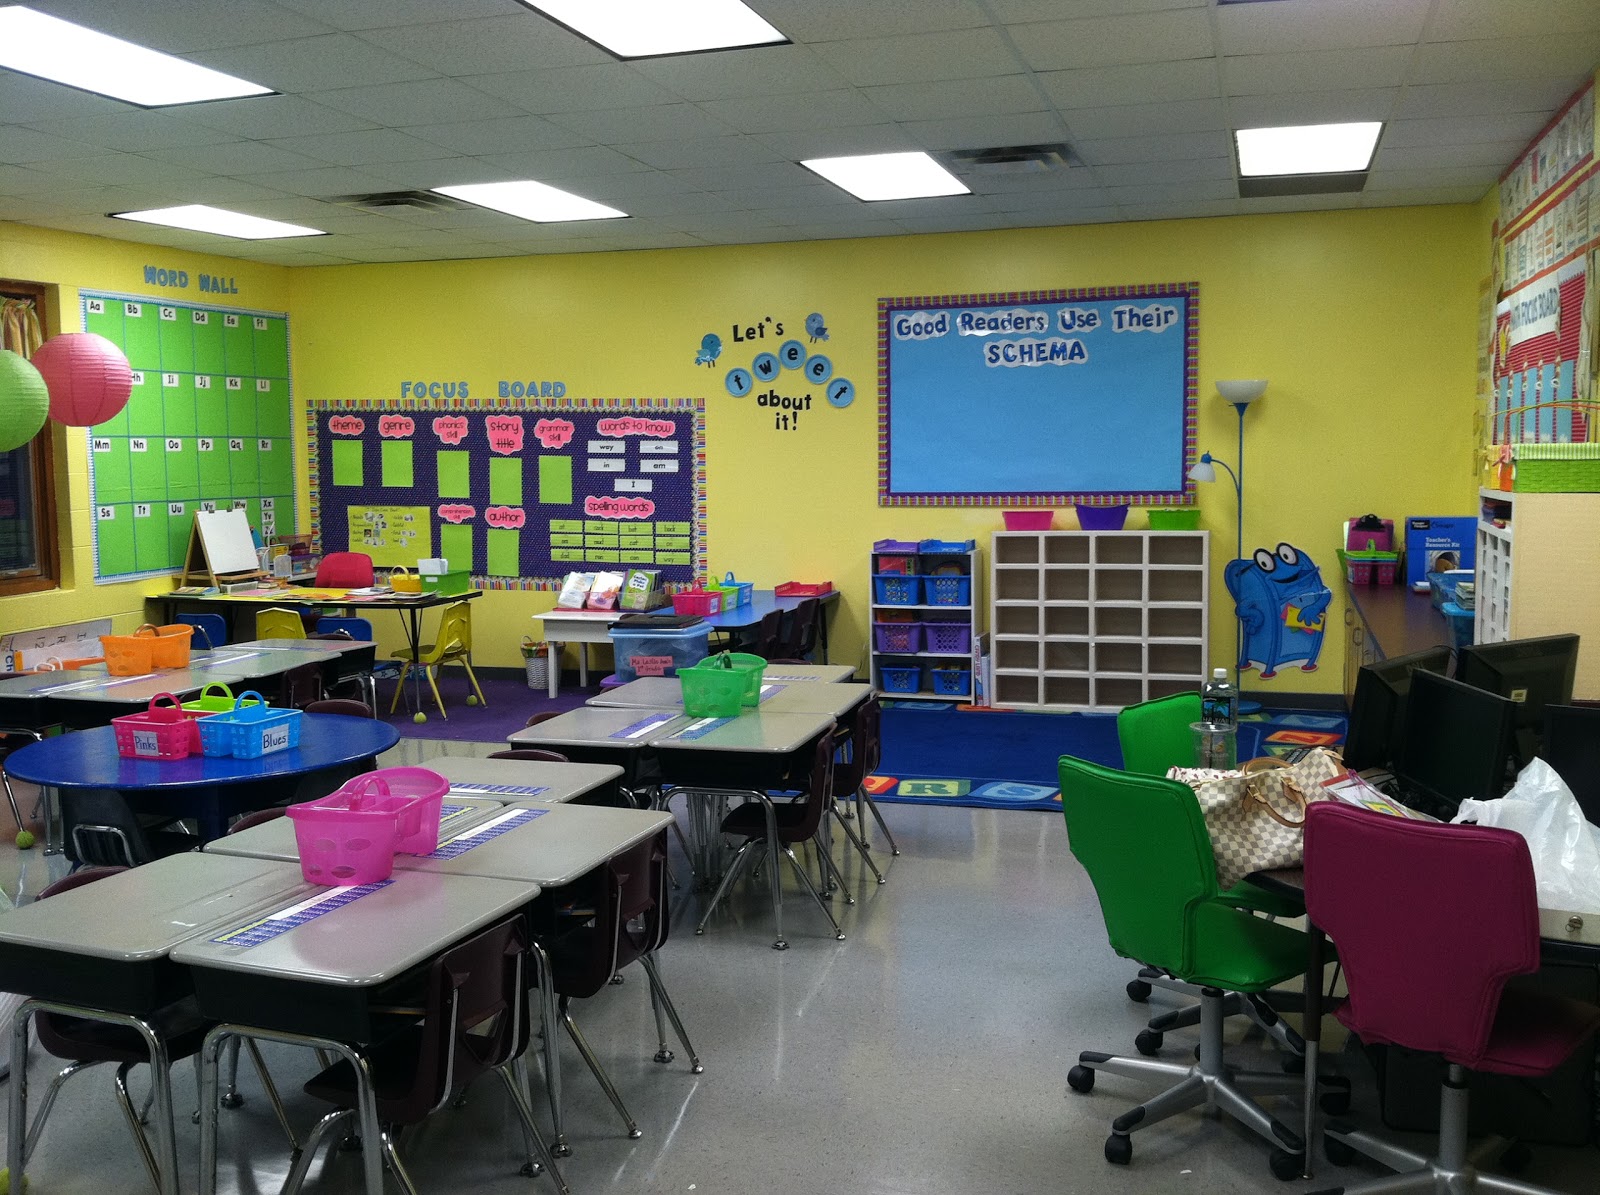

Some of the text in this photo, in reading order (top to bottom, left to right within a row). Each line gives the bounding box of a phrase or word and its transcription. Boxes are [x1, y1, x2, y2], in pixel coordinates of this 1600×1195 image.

[144, 265, 238, 294] WORD WALL
[89, 301, 100, 311] Aa
[127, 304, 138, 314] Bb
[163, 309, 172, 318] Cc
[195, 313, 205, 322] Dd
[227, 316, 235, 325] Ee
[256, 319, 264, 327] Ff
[896, 307, 1174, 336] Good Readers Use Their
[732, 316, 784, 343] Let's
[988, 341, 1085, 363] SCHEMA
[168, 375, 174, 384] Ii
[199, 379, 206, 388] Jj
[229, 379, 238, 387] Kk
[401, 381, 566, 399] FOCUS BOARD
[757, 390, 812, 411] about
[332, 420, 362, 430] theme
[439, 421, 464, 430] phonics
[775, 411, 798, 431] it!
[383, 421, 411, 434] genre
[490, 422, 519, 434] story
[539, 425, 570, 434] grammar
[600, 420, 671, 433] words to know
[94, 440, 109, 449] Mm
[133, 440, 144, 449] Nn
[168, 440, 179, 449] Oo
[201, 440, 210, 450] Pp
[230, 440, 241, 450] Qq
[261, 440, 269, 449] Rr
[600, 444, 614, 452] way
[101, 508, 110, 517] Ss
[138, 506, 146, 515] Tt
[171, 505, 181, 514] Uu
[588, 502, 649, 513] spelling words
[489, 511, 521, 522] author
[135, 735, 157, 750] Pinks
[263, 733, 287, 749] Blues
